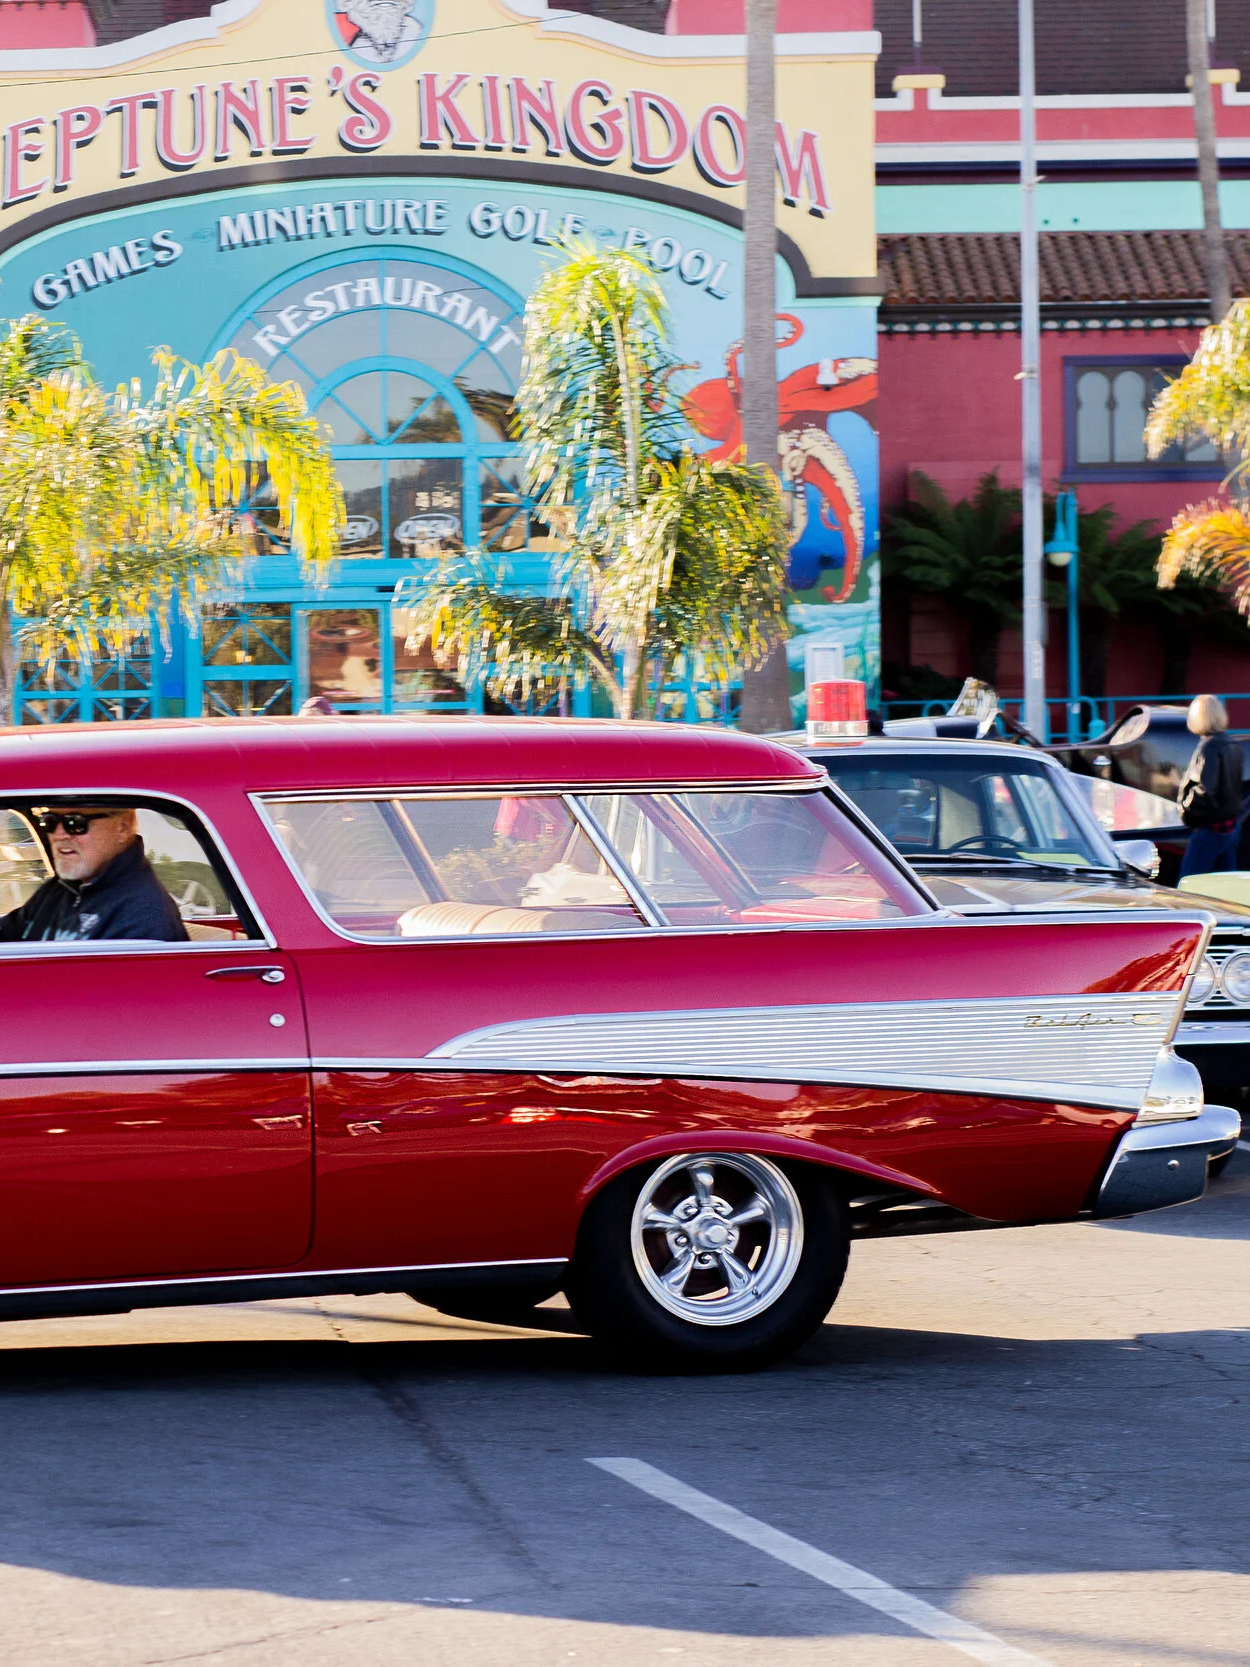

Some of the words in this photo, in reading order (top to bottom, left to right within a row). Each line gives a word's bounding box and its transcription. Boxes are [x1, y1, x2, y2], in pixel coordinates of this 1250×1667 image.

[417, 72, 832, 218] KINGDOM
[31, 230, 183, 309] GAMES
[218, 198, 450, 252] MINIATURE
[469, 201, 588, 246] GOLF
[623, 226, 732, 300] POOL
[251, 276, 522, 357] RESTAURANT
